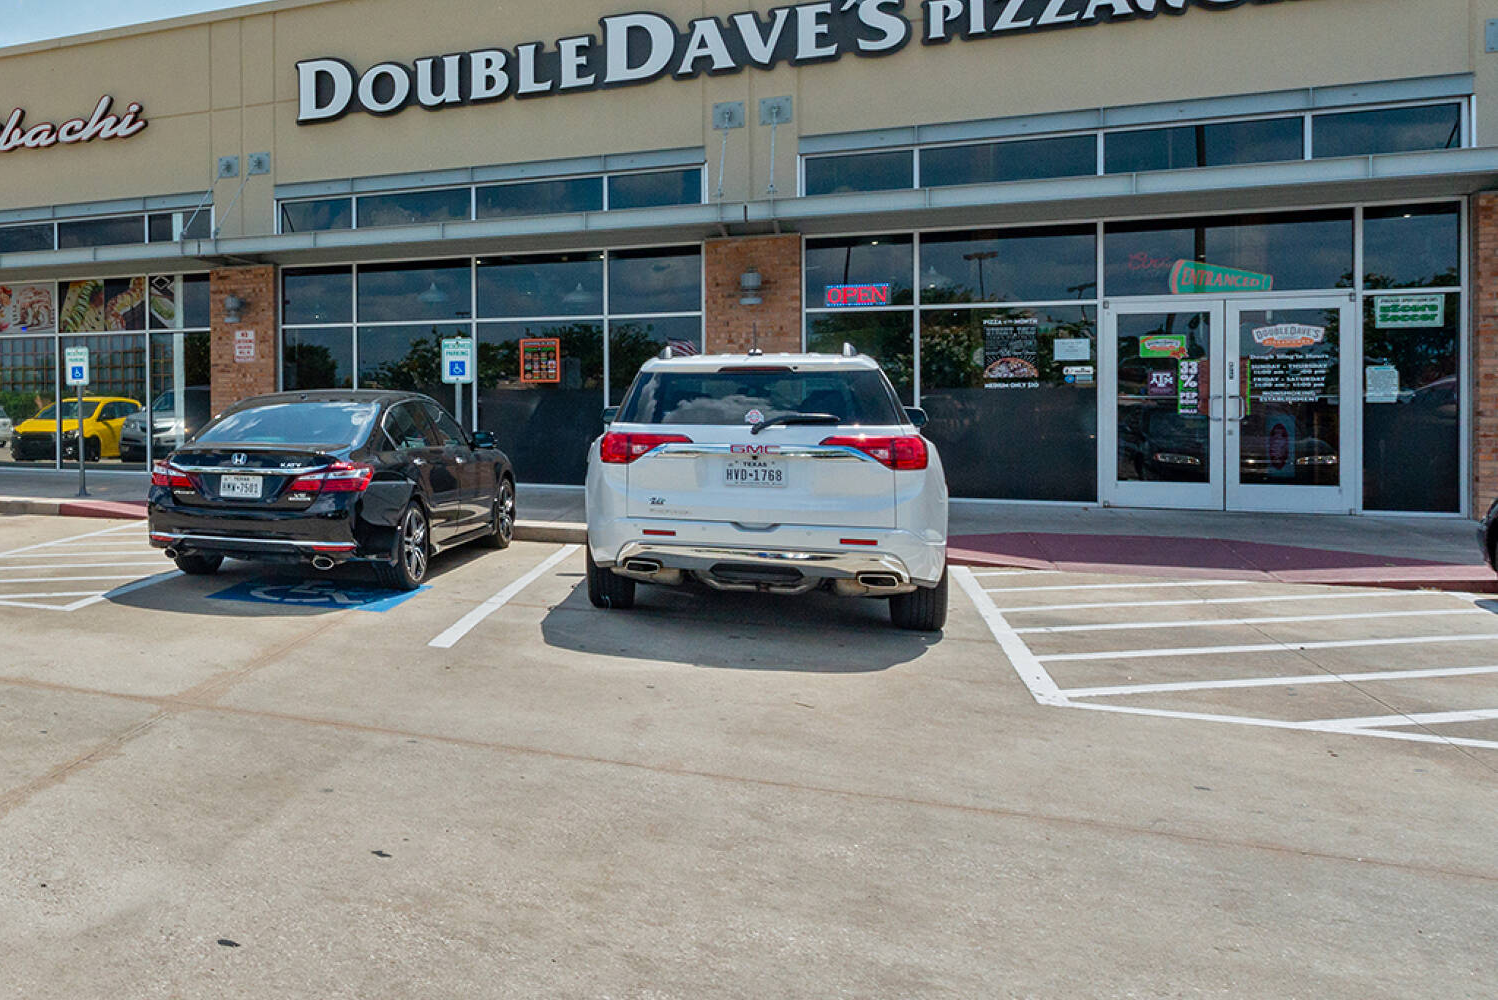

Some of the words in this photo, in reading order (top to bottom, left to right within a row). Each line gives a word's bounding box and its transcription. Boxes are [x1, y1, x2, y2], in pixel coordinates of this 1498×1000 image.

[827, 285, 888, 304] OPEN
[1180, 361, 1198, 375] 33
[730, 444, 781, 454] GMC
